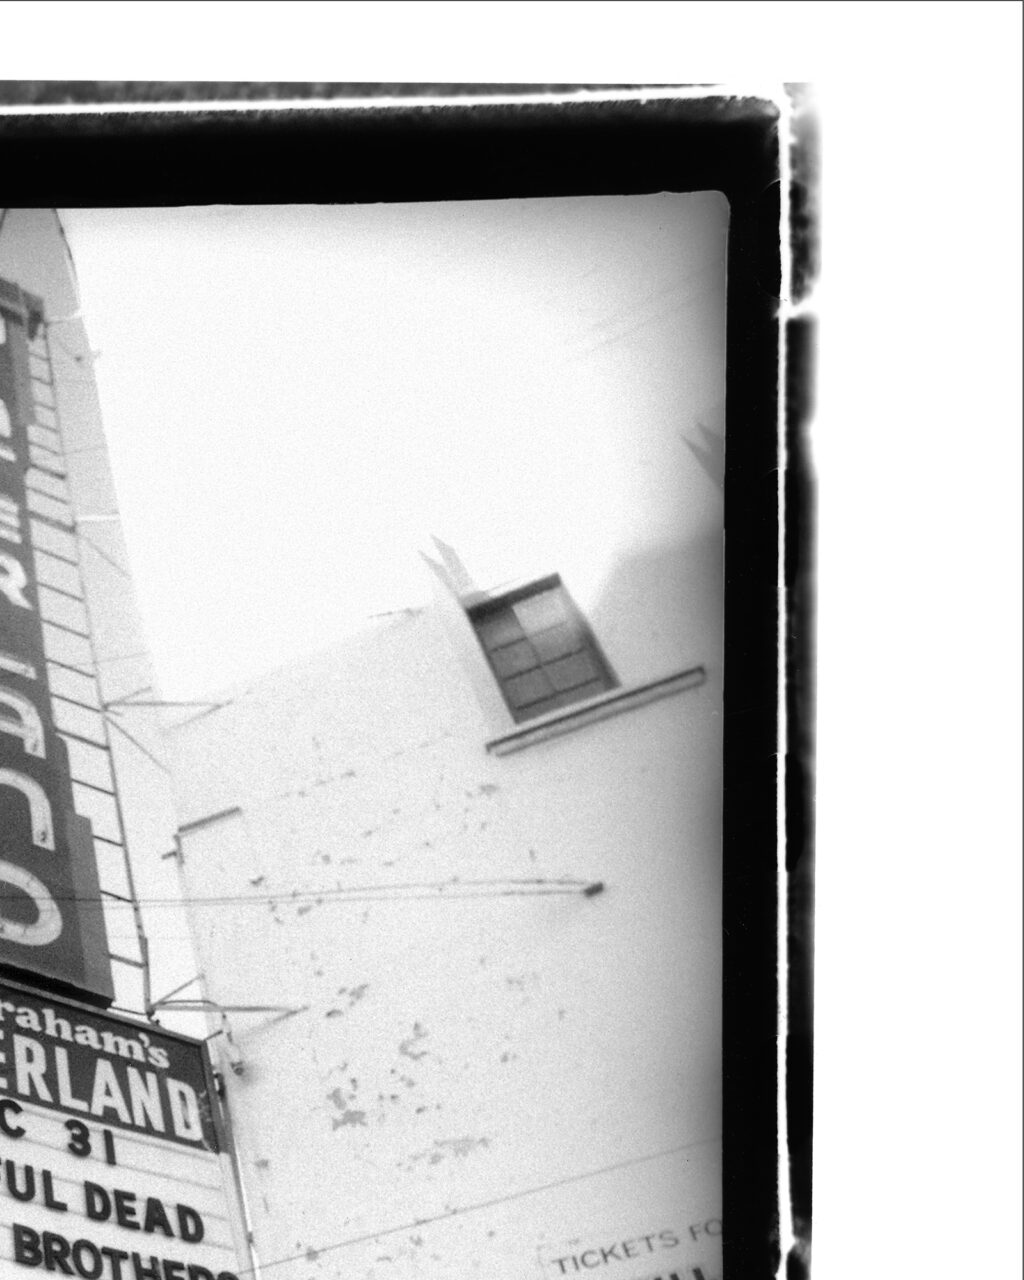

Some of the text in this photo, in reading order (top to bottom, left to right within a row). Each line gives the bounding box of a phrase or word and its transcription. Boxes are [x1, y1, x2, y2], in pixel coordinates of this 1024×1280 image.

[65, 1119, 117, 1166] 31
[84, 1180, 205, 1244] DEAD
[551, 1230, 680, 1274] TICKETS
